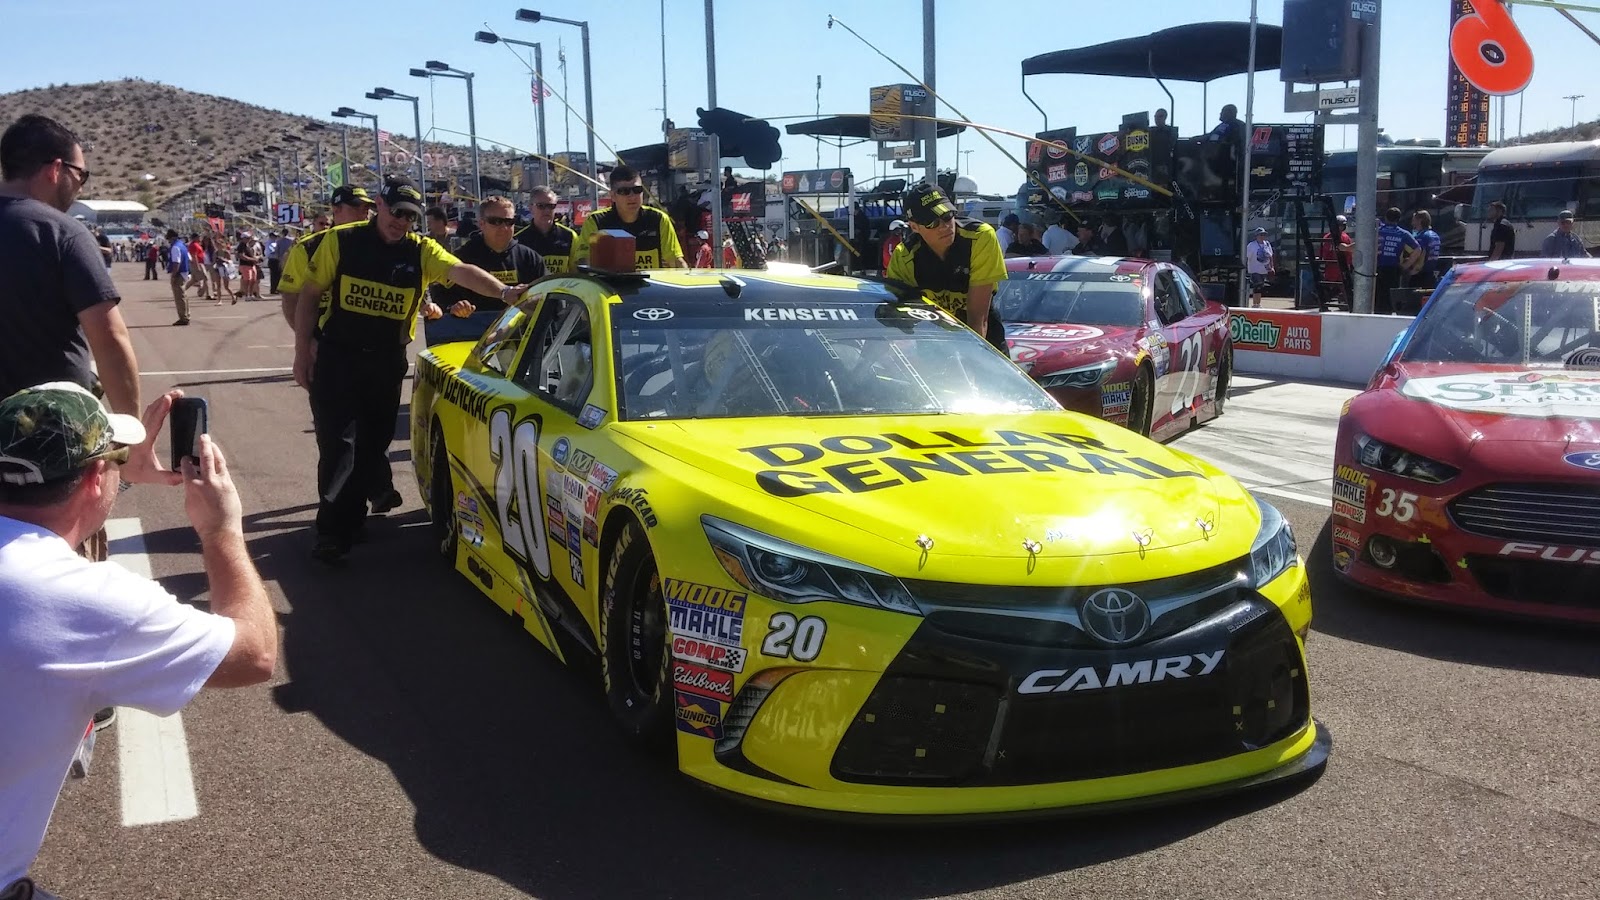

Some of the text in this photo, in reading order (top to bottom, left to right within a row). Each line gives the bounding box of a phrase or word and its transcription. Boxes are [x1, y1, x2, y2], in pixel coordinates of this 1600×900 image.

[277, 203, 300, 224] 51
[345, 295, 406, 315] GENERAL
[350, 283, 405, 304] DOLLAR
[744, 308, 859, 321] KENSETH
[1283, 338, 1312, 350] PARTS
[1286, 327, 1310, 339] AUTO
[1171, 331, 1202, 415] 23
[1102, 382, 1130, 393] MOOG
[1102, 392, 1130, 405] MAHLE
[738, 430, 1128, 466] DOLLAR
[756, 450, 1207, 497] GENERAL
[1335, 465, 1370, 486] MOOG
[489, 405, 552, 580] 20
[1333, 481, 1366, 504] MAHLE
[1375, 488, 1419, 522] 35
[667, 580, 745, 612] MOOG
[669, 605, 743, 641] MAHLE
[761, 612, 828, 662] 20
[673, 637, 727, 661] COMP
[708, 658, 735, 669] CAMS
[1018, 649, 1225, 694] CAMRY
[673, 665, 732, 696] Edelbrock
[677, 708, 718, 726] SUNOCO
